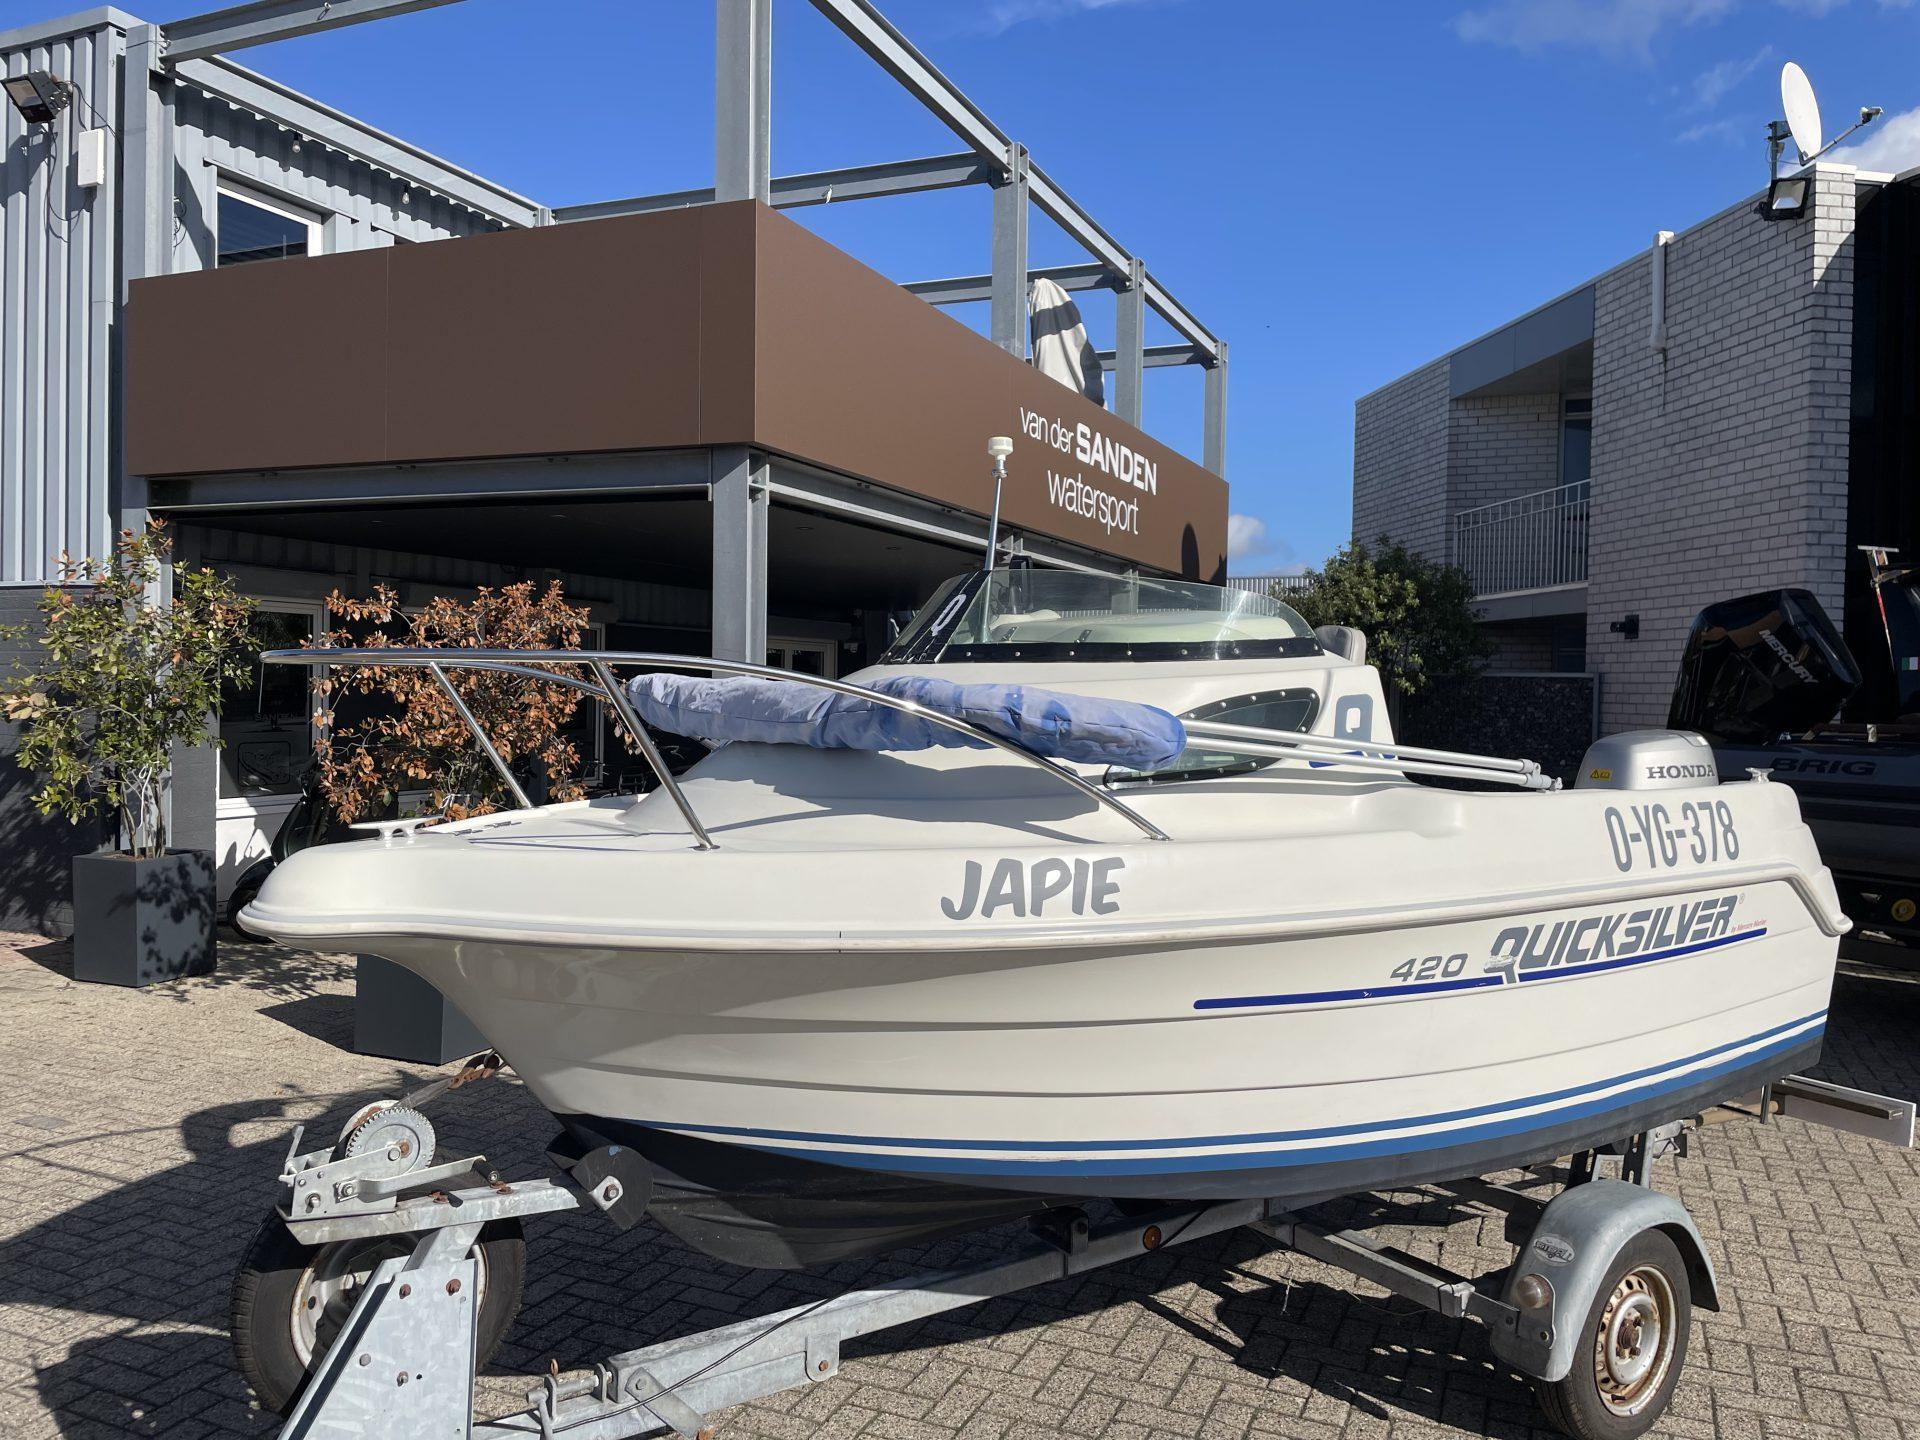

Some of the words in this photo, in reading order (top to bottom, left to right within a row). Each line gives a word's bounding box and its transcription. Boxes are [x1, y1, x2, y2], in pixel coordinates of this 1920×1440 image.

[1020, 406, 1048, 443] van
[1050, 418, 1074, 454] der
[1075, 422, 1157, 495] SANDEN
[1048, 470, 1139, 535] watersport
[1759, 629, 1820, 683] MERCURY
[1646, 765, 1715, 779] HONDA
[1769, 757, 1877, 776] BRIG
[940, 856, 1126, 921] JAPIE
[1390, 953, 1469, 982] 420
[1483, 895, 1738, 984] QUICKSILVER
